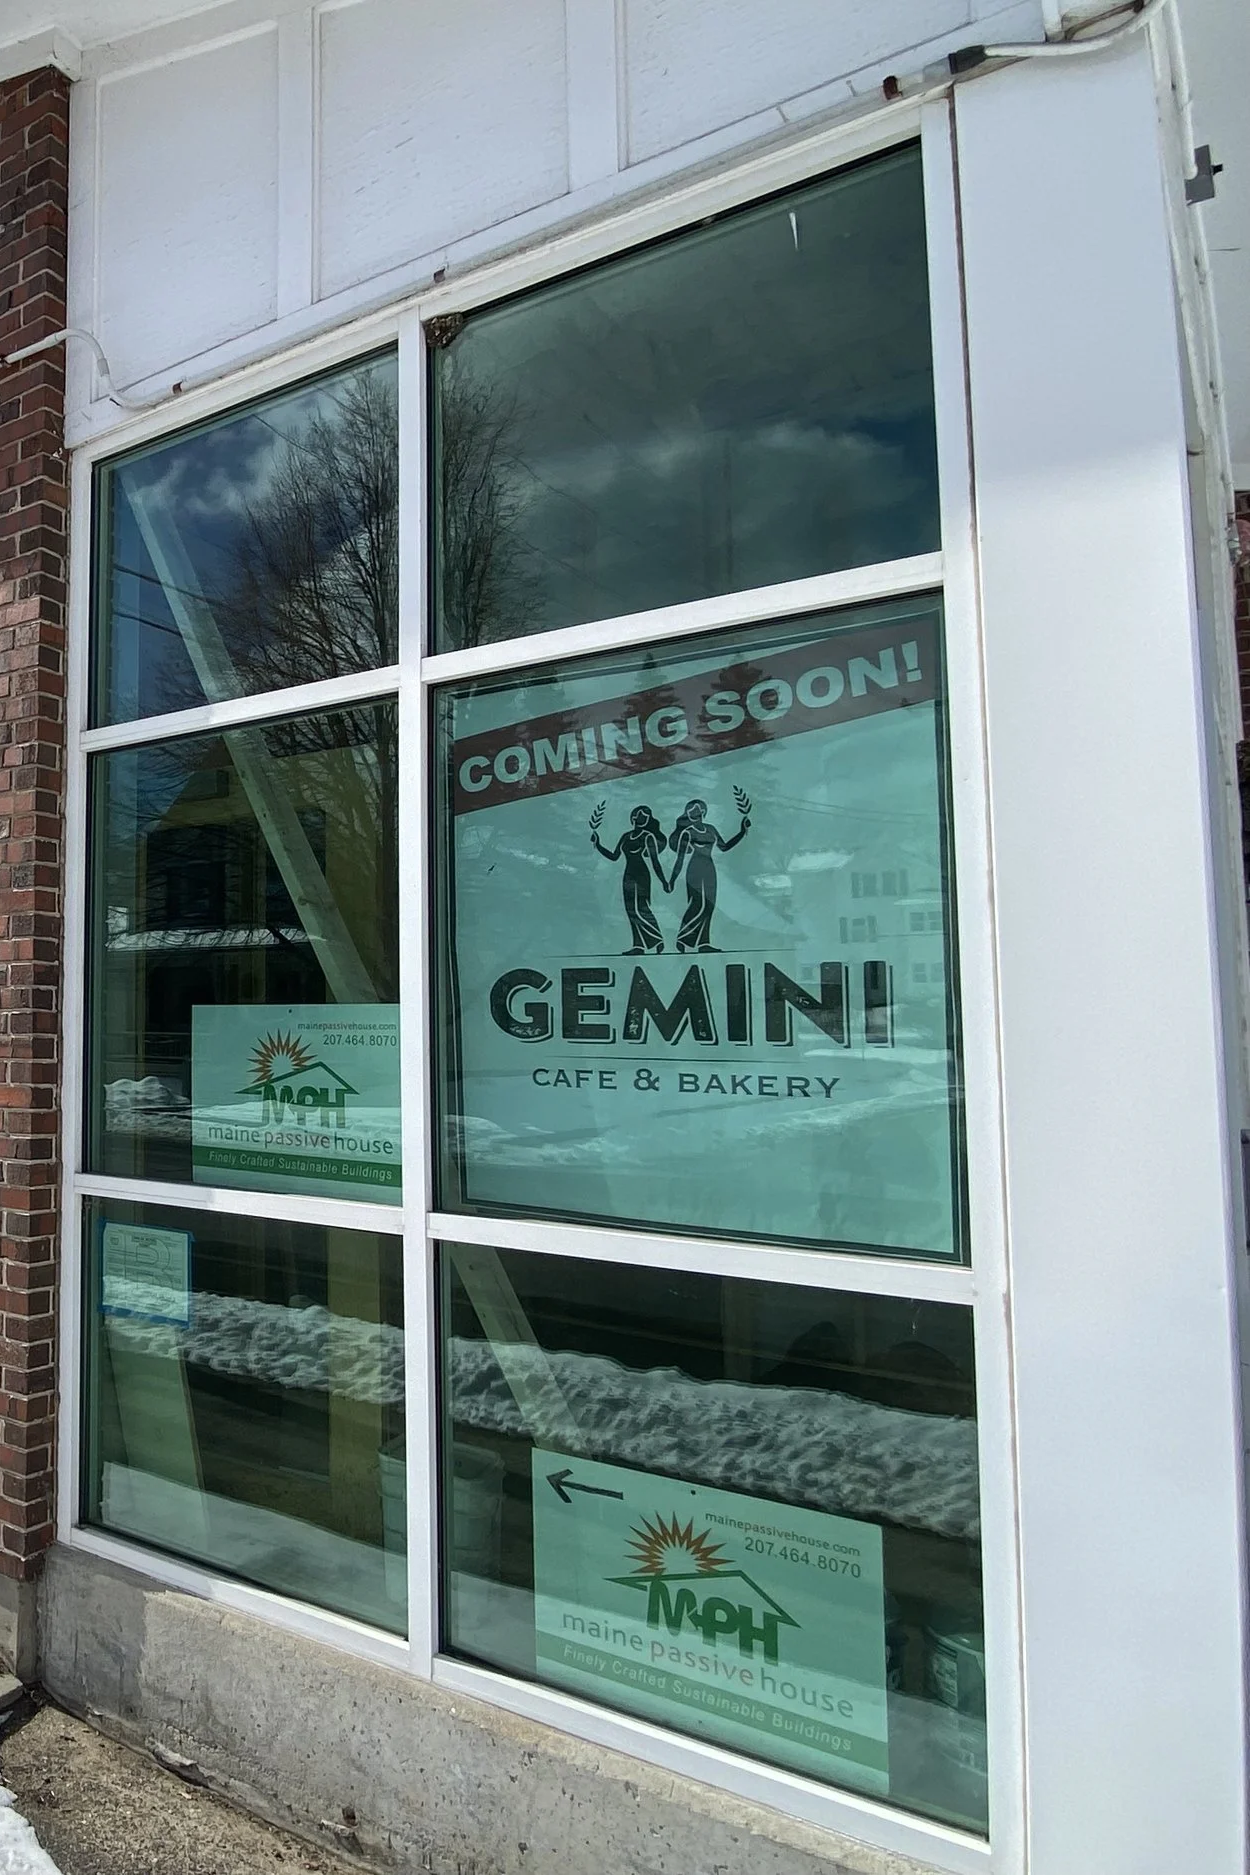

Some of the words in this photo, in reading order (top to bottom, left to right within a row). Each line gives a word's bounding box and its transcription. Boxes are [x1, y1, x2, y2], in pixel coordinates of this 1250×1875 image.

[458, 706, 689, 793] COMING
[705, 640, 922, 733] SOON!
[490, 960, 894, 1049] GEMINI
[298, 1022, 397, 1032] mainepassivehouse.com
[323, 1034, 397, 1047] 207.464.8070
[533, 1068, 617, 1090] CAFE
[633, 1068, 660, 1092] &
[678, 1072, 840, 1099] BAKERY
[208, 1125, 260, 1144] maine
[264, 1131, 330, 1148] passive
[334, 1131, 394, 1155] house
[208, 1151, 237, 1166] Finely
[240, 1153, 275, 1168] Crafted
[278, 1157, 338, 1174] Sustainable
[341, 1163, 392, 1181] Buildings
[704, 1512, 861, 1557] mainepassivehouse.com
[744, 1537, 861, 1578] 207.464.8070
[562, 1612, 643, 1651] maine
[650, 1639, 754, 1687] passive
[760, 1667, 854, 1719] house
[564, 1645, 606, 1670] Finely
[612, 1660, 667, 1690] Crafted
[672, 1680, 766, 1721] Sustainable
[772, 1713, 852, 1751] Buildings
